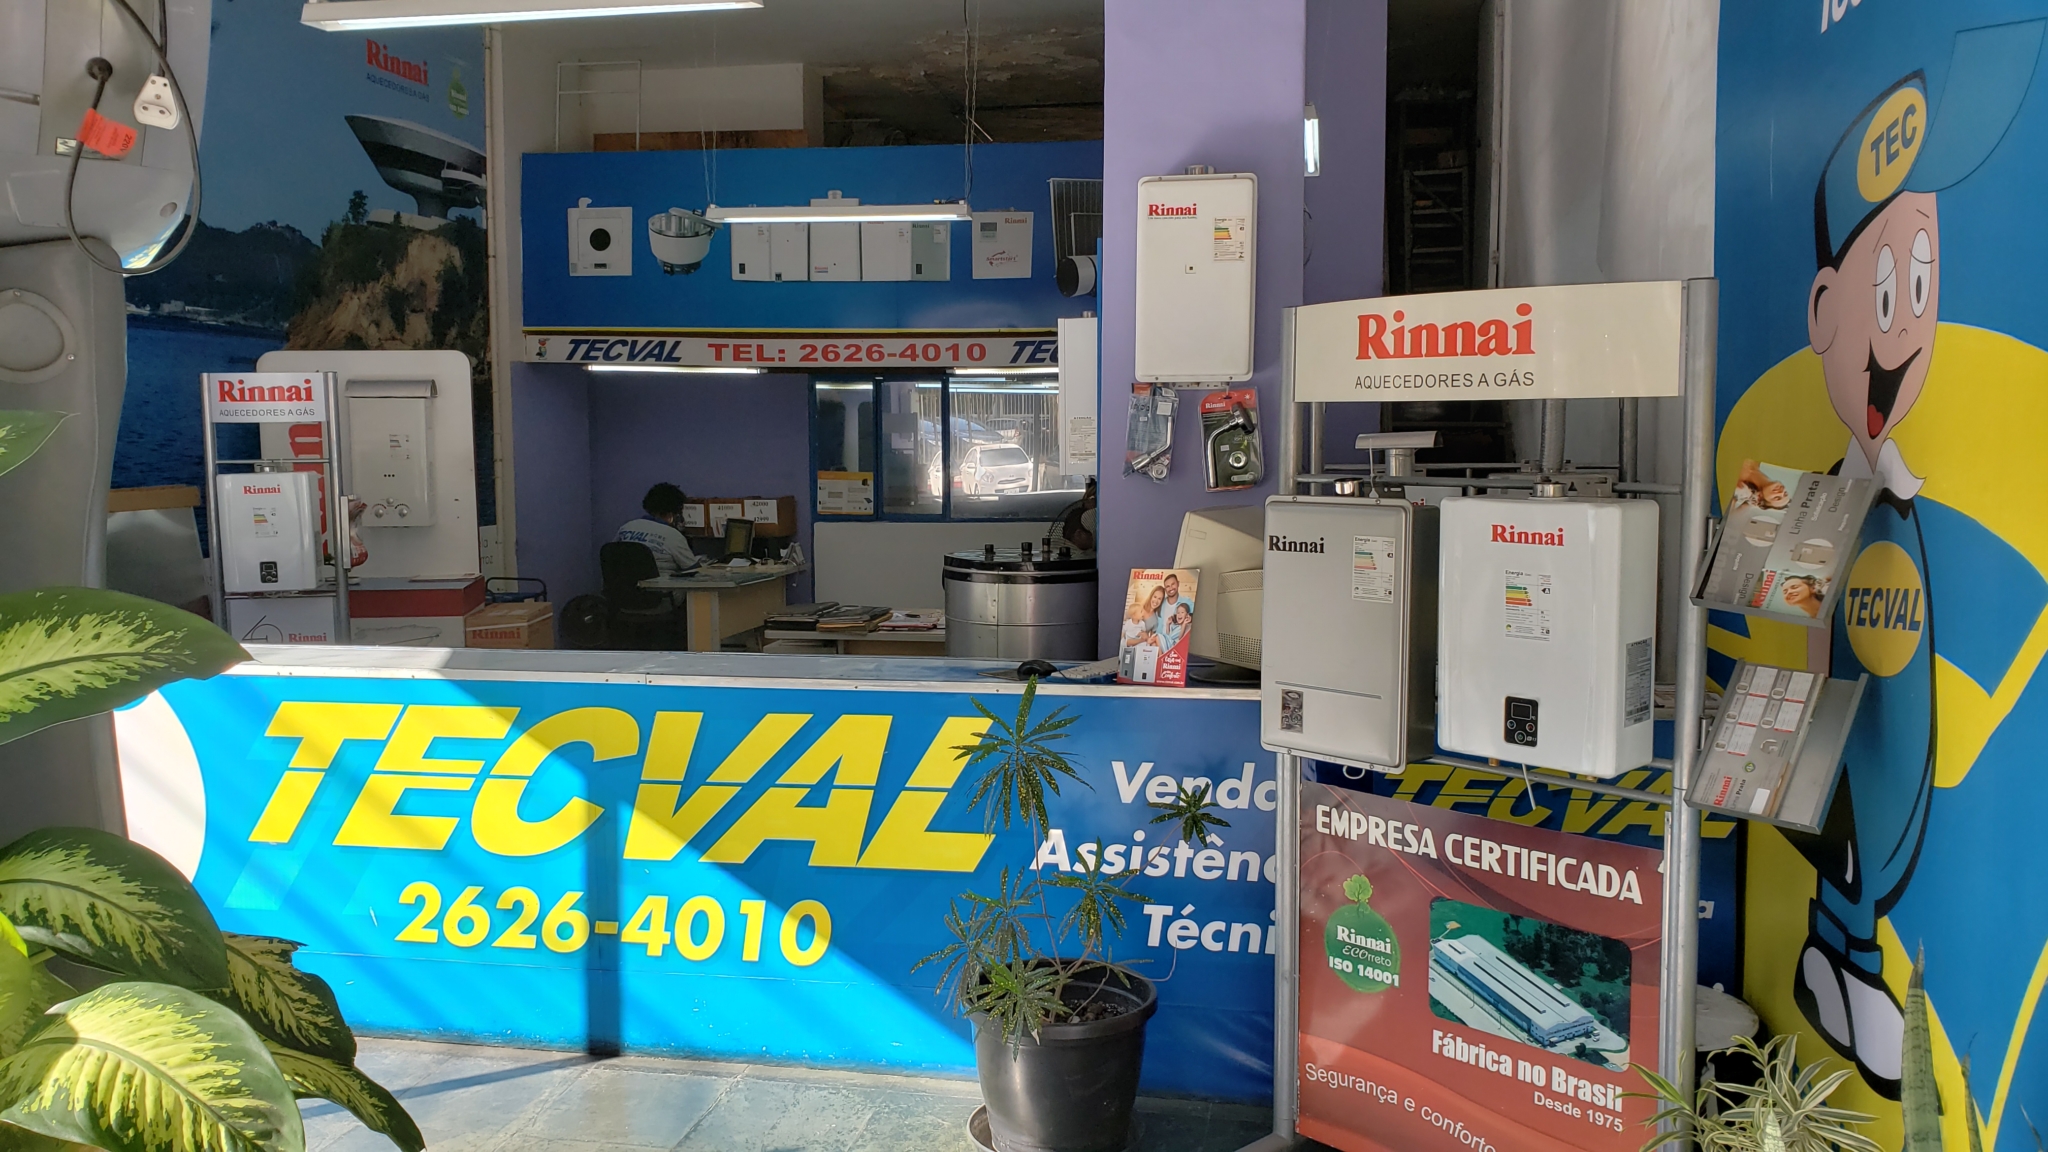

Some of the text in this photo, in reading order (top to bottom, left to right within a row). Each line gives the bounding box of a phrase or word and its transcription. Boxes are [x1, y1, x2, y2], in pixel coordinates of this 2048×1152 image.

[366, 38, 429, 86] Rinnai
[1870, 103, 1918, 177] TEC
[1148, 203, 1197, 217] Rinnai
[1355, 303, 1536, 361] Rinnai
[565, 338, 1059, 364] TECVAL TEL: 2626-4010 TE
[217, 378, 315, 402] Rinnai
[1355, 368, 1535, 391] AQUECEDORES A GÁS
[219, 406, 316, 417] AQUECEDORES A GÁS
[243, 484, 281, 494] Rinnai
[1828, 486, 1847, 513] Design
[1789, 479, 1821, 536] Linha Prata
[1268, 535, 1325, 554] Rinnai
[1491, 524, 1565, 547] Rinnai
[1133, 571, 1164, 581] Rinnai
[1505, 569, 1524, 577] Energia
[1738, 572, 1755, 600] Design
[1751, 569, 1777, 608] Rinnai
[1847, 588, 1922, 632] TECVAL
[288, 632, 327, 643] Rinnai
[472, 629, 522, 640] Rinnai
[248, 700, 997, 873] TECVAL
[1713, 775, 1733, 807] Rinnai
[1735, 778, 1747, 796] Prata
[1316, 804, 1643, 905] EMPRESA CERTIFICADA
[394, 880, 833, 967] 2626-4010
[1336, 925, 1392, 954] Rinnai
[1328, 955, 1400, 988] ISO 14001
[1432, 1029, 1623, 1113] Fábrica no Brasil
[1305, 1062, 1497, 1152] Segurança e conforto
[1534, 1091, 1623, 1132] Desde 1975
